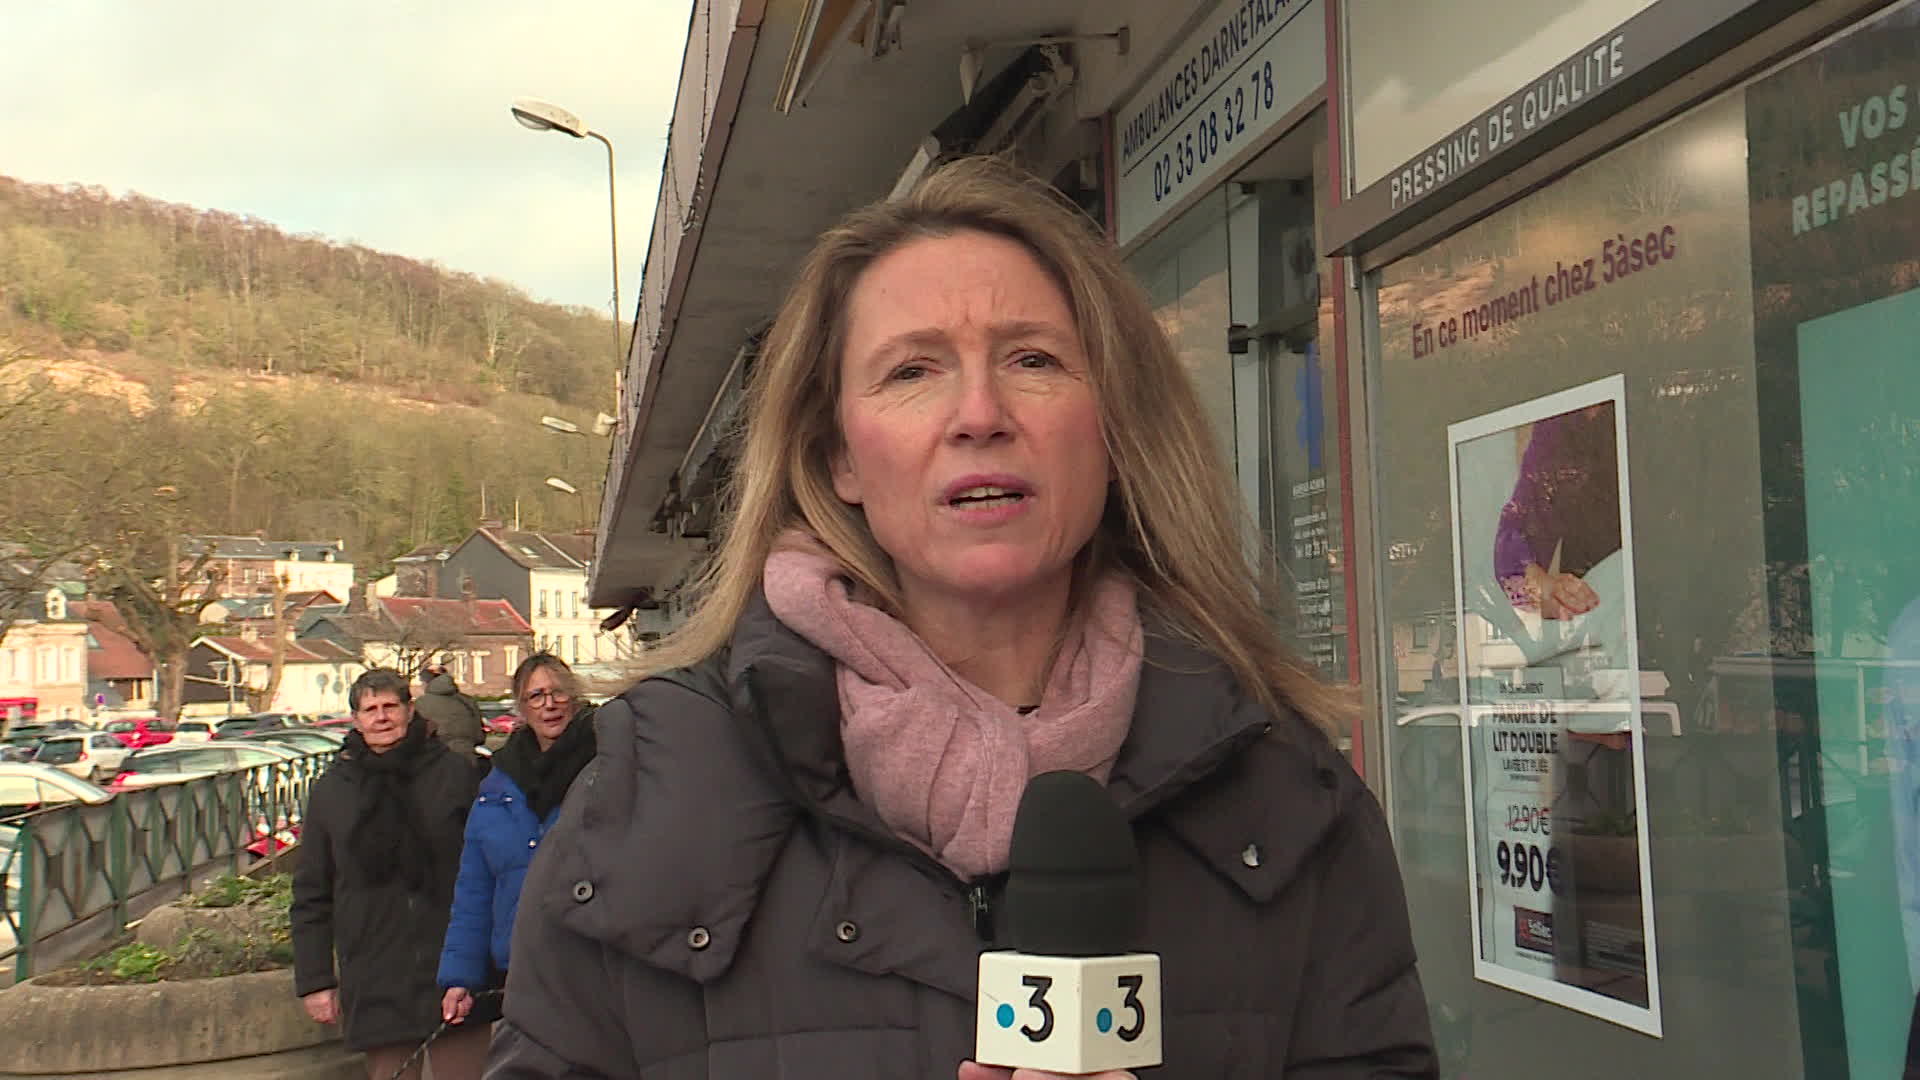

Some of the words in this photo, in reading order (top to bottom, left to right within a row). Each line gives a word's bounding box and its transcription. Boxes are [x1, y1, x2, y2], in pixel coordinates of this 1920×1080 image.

[1123, 57, 1198, 161] AMBULANCES
[1202, 0, 1290, 85] DARNETAL
[1839, 84, 1908, 149] VOS
[1154, 153, 1171, 202] 02
[1176, 133, 1194, 184] 35
[1198, 111, 1218, 164] 08
[1224, 87, 1245, 142] 32
[1251, 61, 1274, 120] 78
[1390, 126, 1482, 209] PRESSING
[1488, 105, 1514, 151] DE
[1412, 321, 1434, 360] En
[1439, 316, 1459, 350] ce
[1462, 274, 1541, 341] moment
[1544, 256, 1595, 305] chez
[1602, 223, 1677, 284] 5àsec
[1493, 731, 1508, 752] LIT
[1511, 731, 1559, 754] DOUBLE
[1020, 976, 1054, 1042] 3
[1117, 976, 1145, 1042] 3
